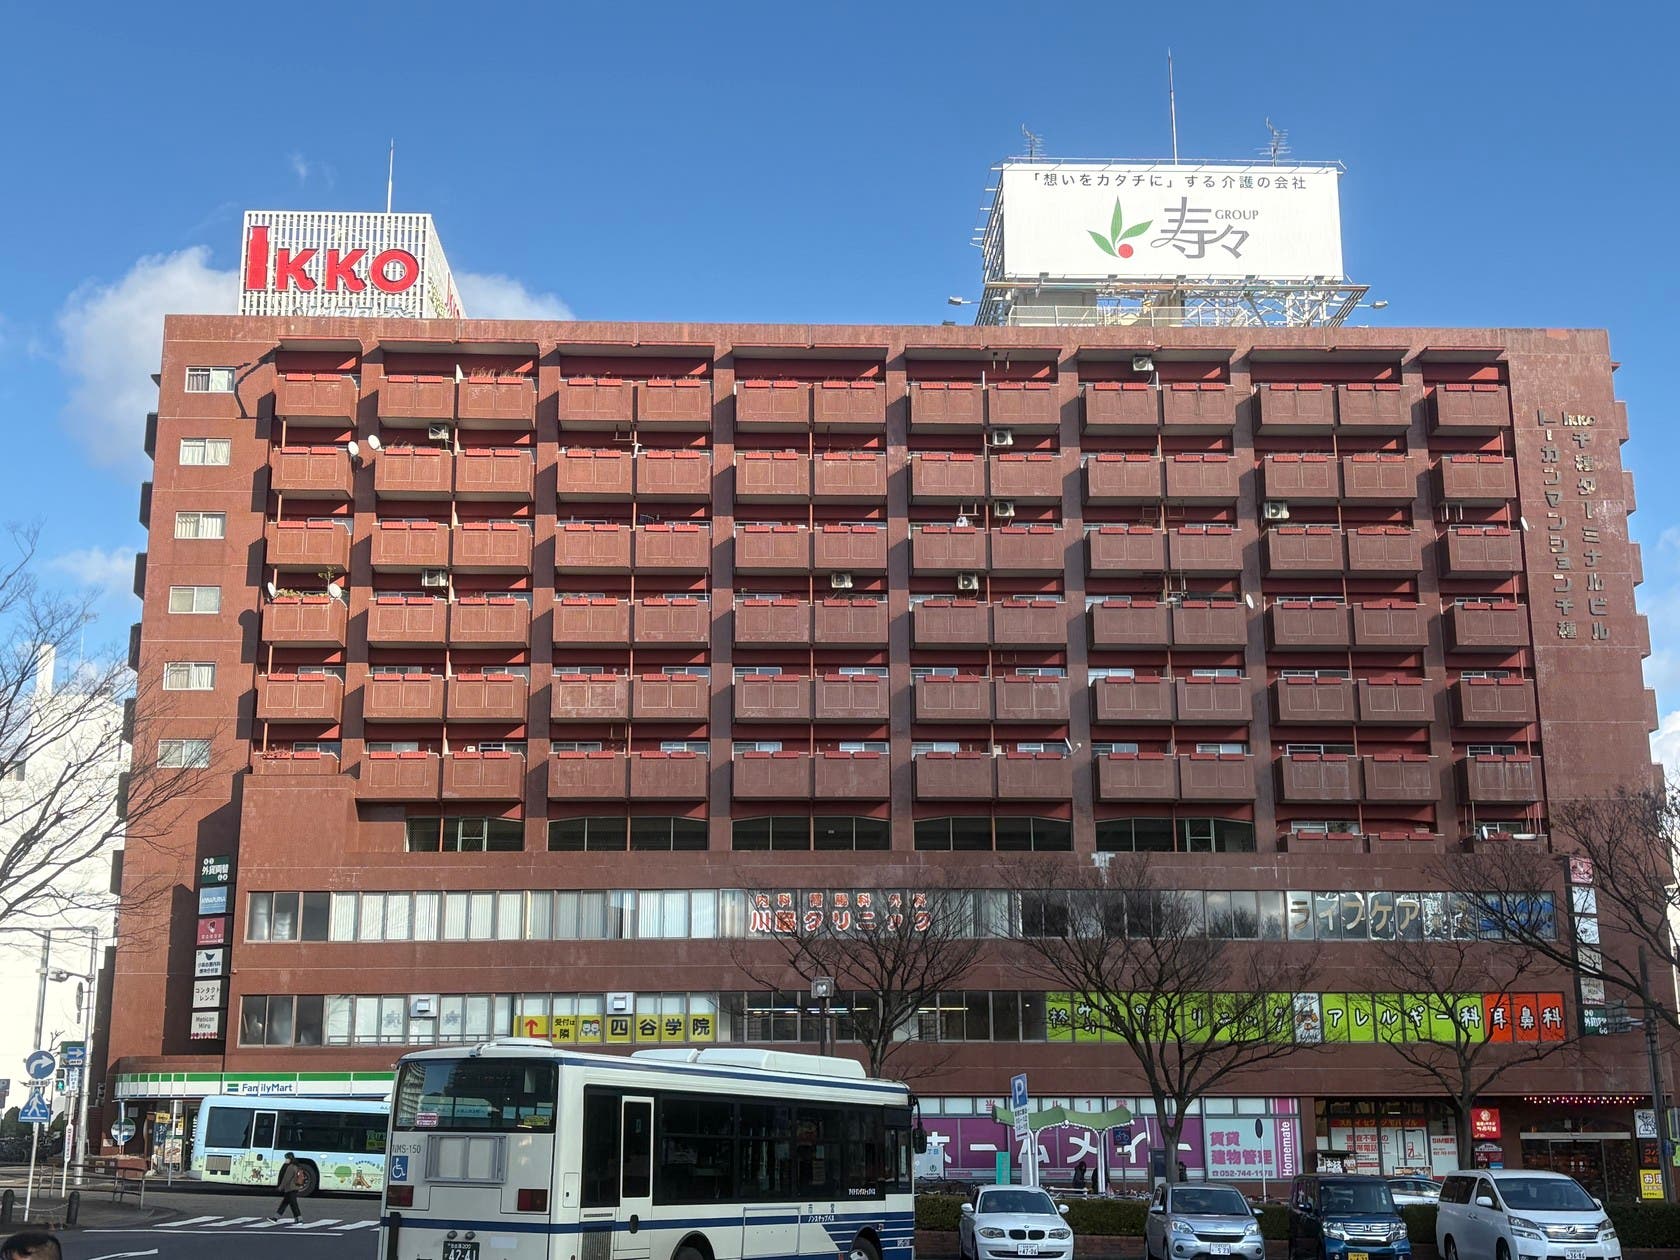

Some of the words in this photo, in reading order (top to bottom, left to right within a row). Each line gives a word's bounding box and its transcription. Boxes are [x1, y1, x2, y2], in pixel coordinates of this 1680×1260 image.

[1033, 173, 1307, 190] 「想いをカタチに」する介護の会社
[1214, 208, 1259, 221] GROUP
[1150, 196, 1250, 259] 寿々
[246, 225, 419, 294] IKKO
[1572, 432, 1611, 640] 千種ターミナルビル
[756, 893, 792, 908] 内科
[195, 986, 220, 994] コンタクト
[199, 994, 215, 1002] レンズ
[554, 1018, 575, 1026] 受付は
[1327, 1007, 1480, 1030] アレルギー科
[1490, 1007, 1562, 1030] 耳鼻科
[559, 1028, 570, 1039] 隣
[610, 1018, 711, 1036] 四谷学院
[242, 1083, 293, 1094] FamilyMart
[1014, 1079, 1024, 1105] P
[1210, 1131, 1241, 1147] 賃貸
[1280, 1121, 1293, 1176] Homemate
[1211, 1149, 1273, 1165] 建物管理
